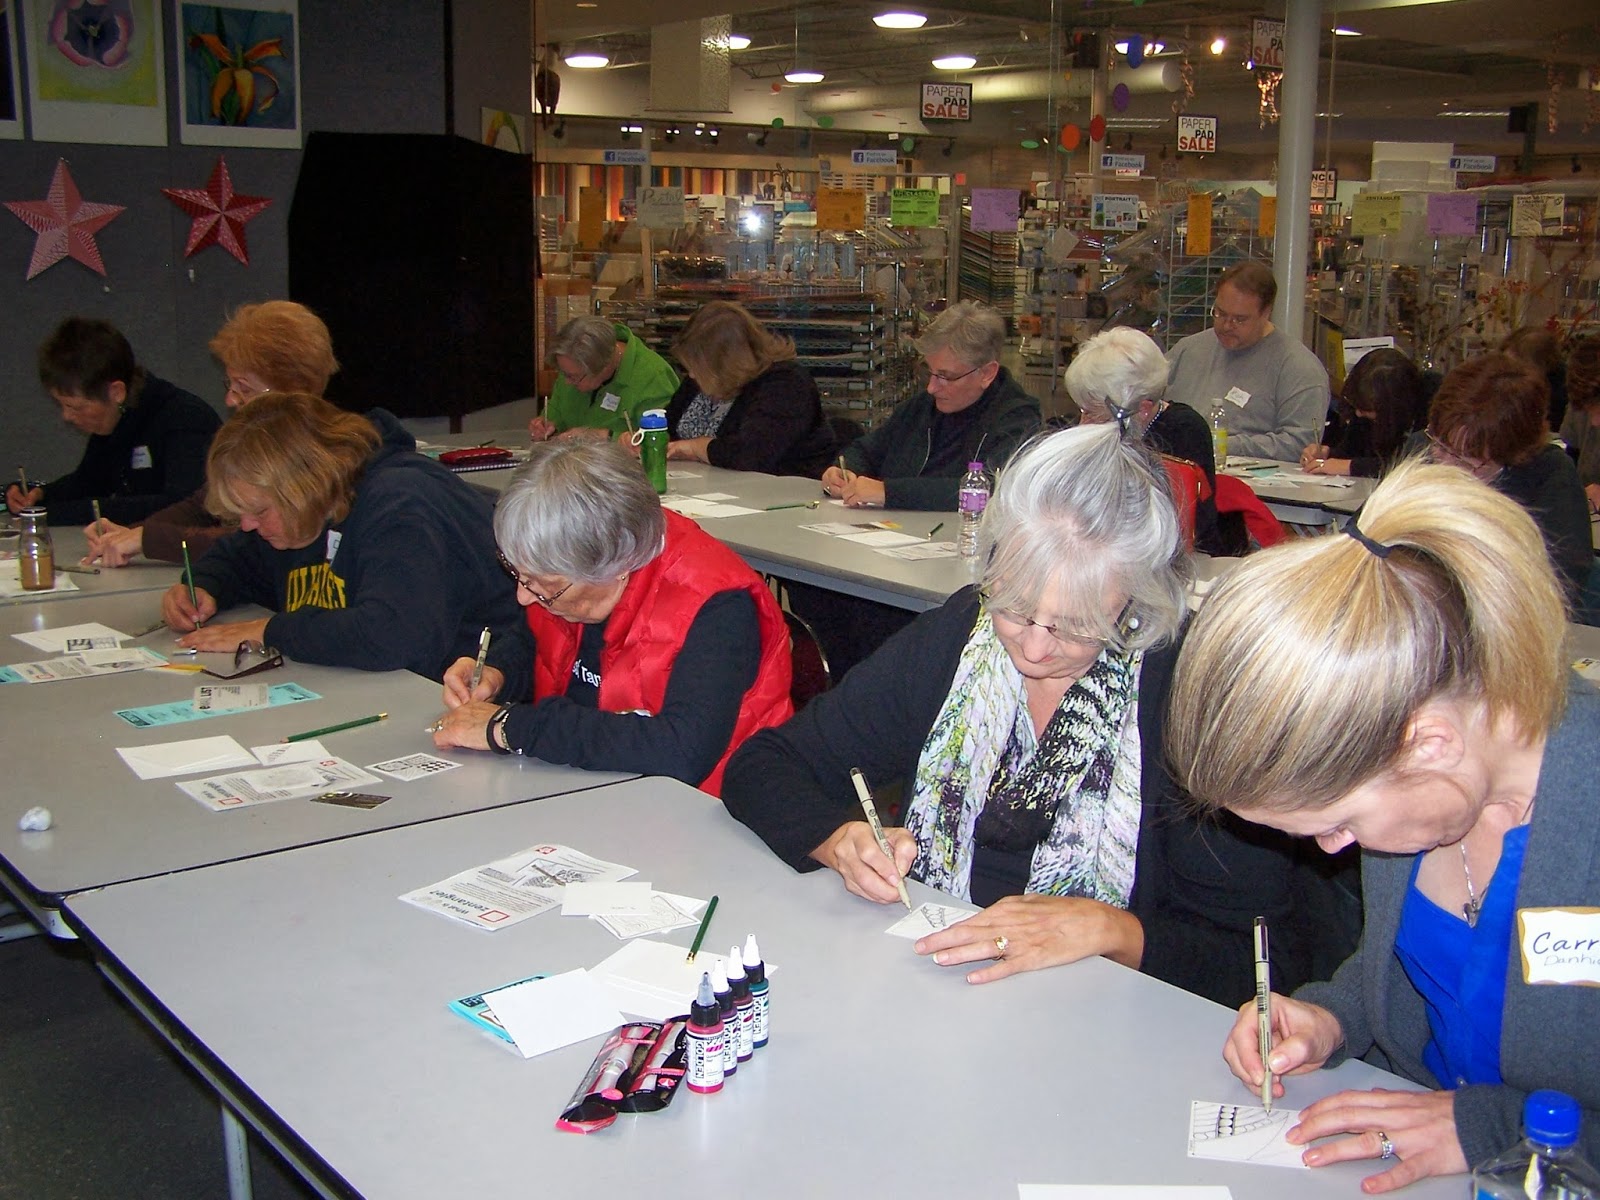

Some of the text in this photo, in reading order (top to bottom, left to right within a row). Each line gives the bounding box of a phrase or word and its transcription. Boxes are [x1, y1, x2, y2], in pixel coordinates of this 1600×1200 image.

[1270, 38, 1284, 52] PA
[926, 85, 964, 97] PAPER
[944, 97, 967, 106] PAD
[924, 103, 968, 118] SALE
[1181, 117, 1211, 130] PAPER
[1195, 129, 1214, 139] PAD
[1179, 136, 1214, 151] SALE
[1115, 160, 1142, 168] Facebook
[429, 889, 490, 912] zentangle?
[1532, 931, 1600, 955] Carr
[753, 998, 761, 1034] GOLDEN
[723, 1026, 731, 1062] GOLDEN
[696, 1041, 704, 1078] GOLDEN
